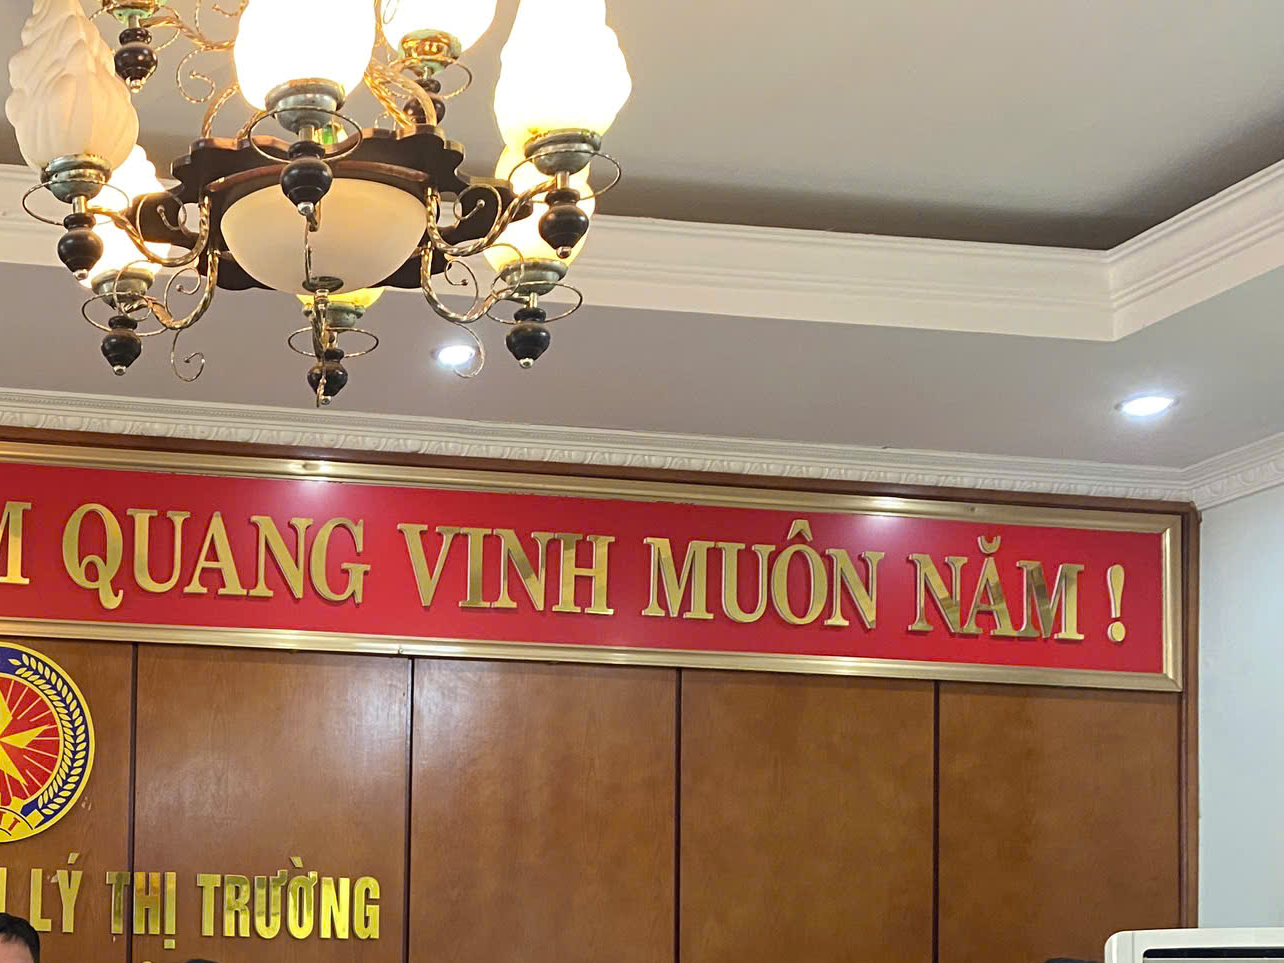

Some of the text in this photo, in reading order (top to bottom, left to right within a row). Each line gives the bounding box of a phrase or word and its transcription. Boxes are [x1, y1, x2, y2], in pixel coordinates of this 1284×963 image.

[62, 503, 371, 610] QUANG
[397, 523, 615, 616] VINH
[641, 519, 884, 630] MUÔN
[908, 535, 1084, 640] NĂM
[1106, 564, 1127, 643] !
[30, 852, 83, 932] LÝ
[106, 871, 177, 950] THỊ
[197, 856, 381, 939] TRƯỜNG
